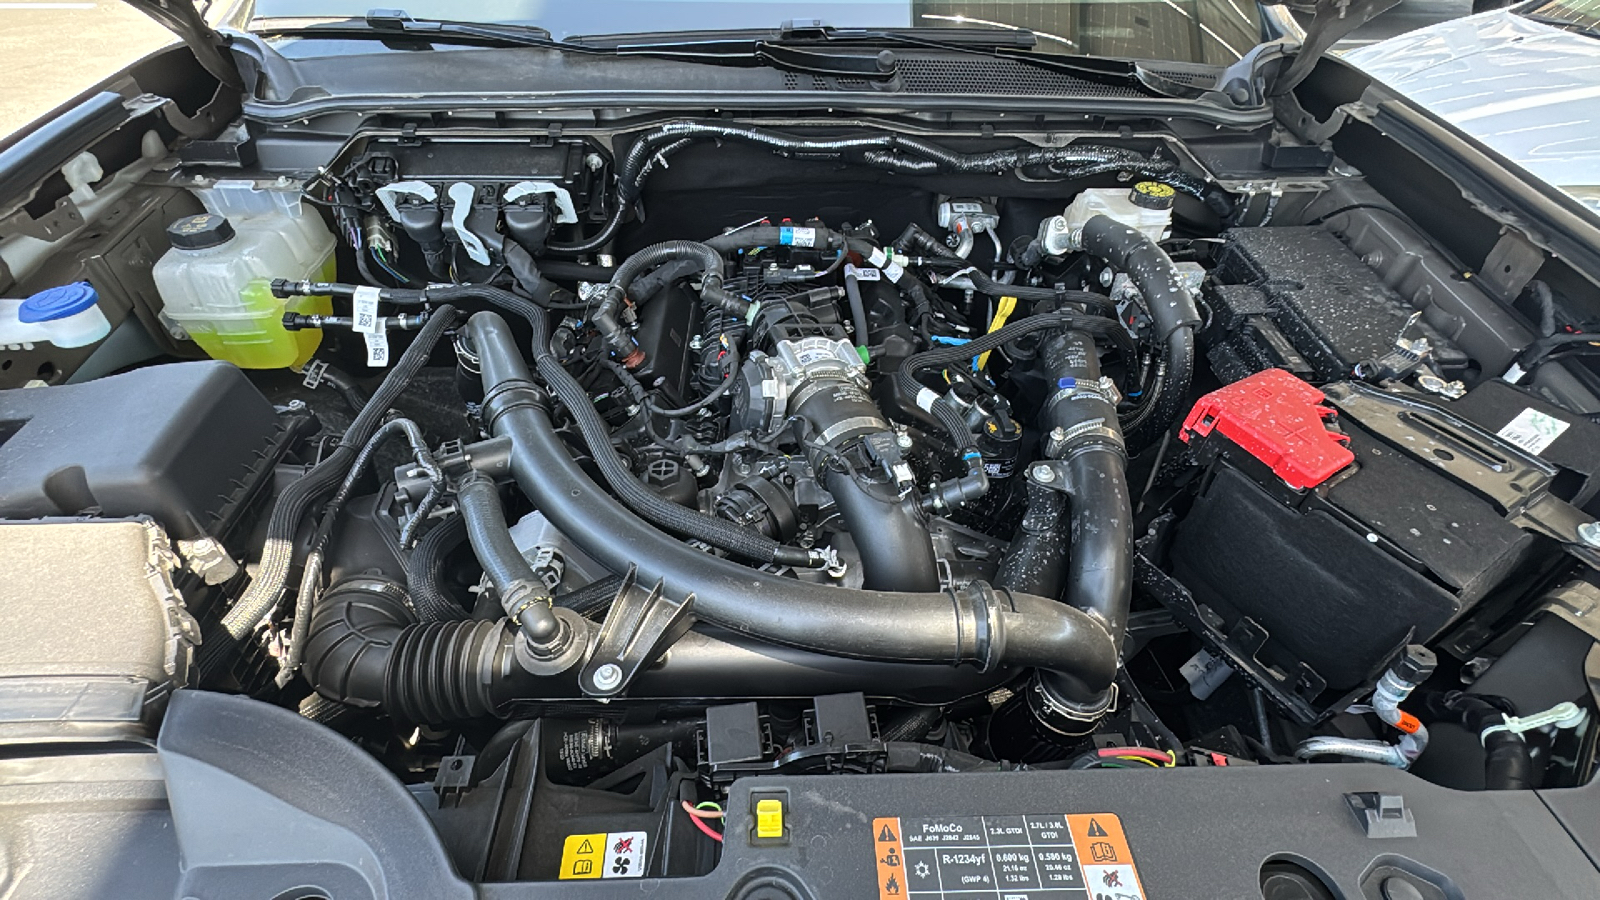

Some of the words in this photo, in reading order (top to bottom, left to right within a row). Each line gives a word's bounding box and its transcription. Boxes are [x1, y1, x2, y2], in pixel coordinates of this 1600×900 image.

[922, 823, 963, 833] FoMoCo
[1041, 831, 1059, 839] GTDI
[942, 853, 986, 866] R-1234yf
[996, 853, 1017, 862] 0.600
[1018, 853, 1029, 863] kg
[1061, 852, 1072, 862] kg
[961, 875, 981, 885] (GWP
